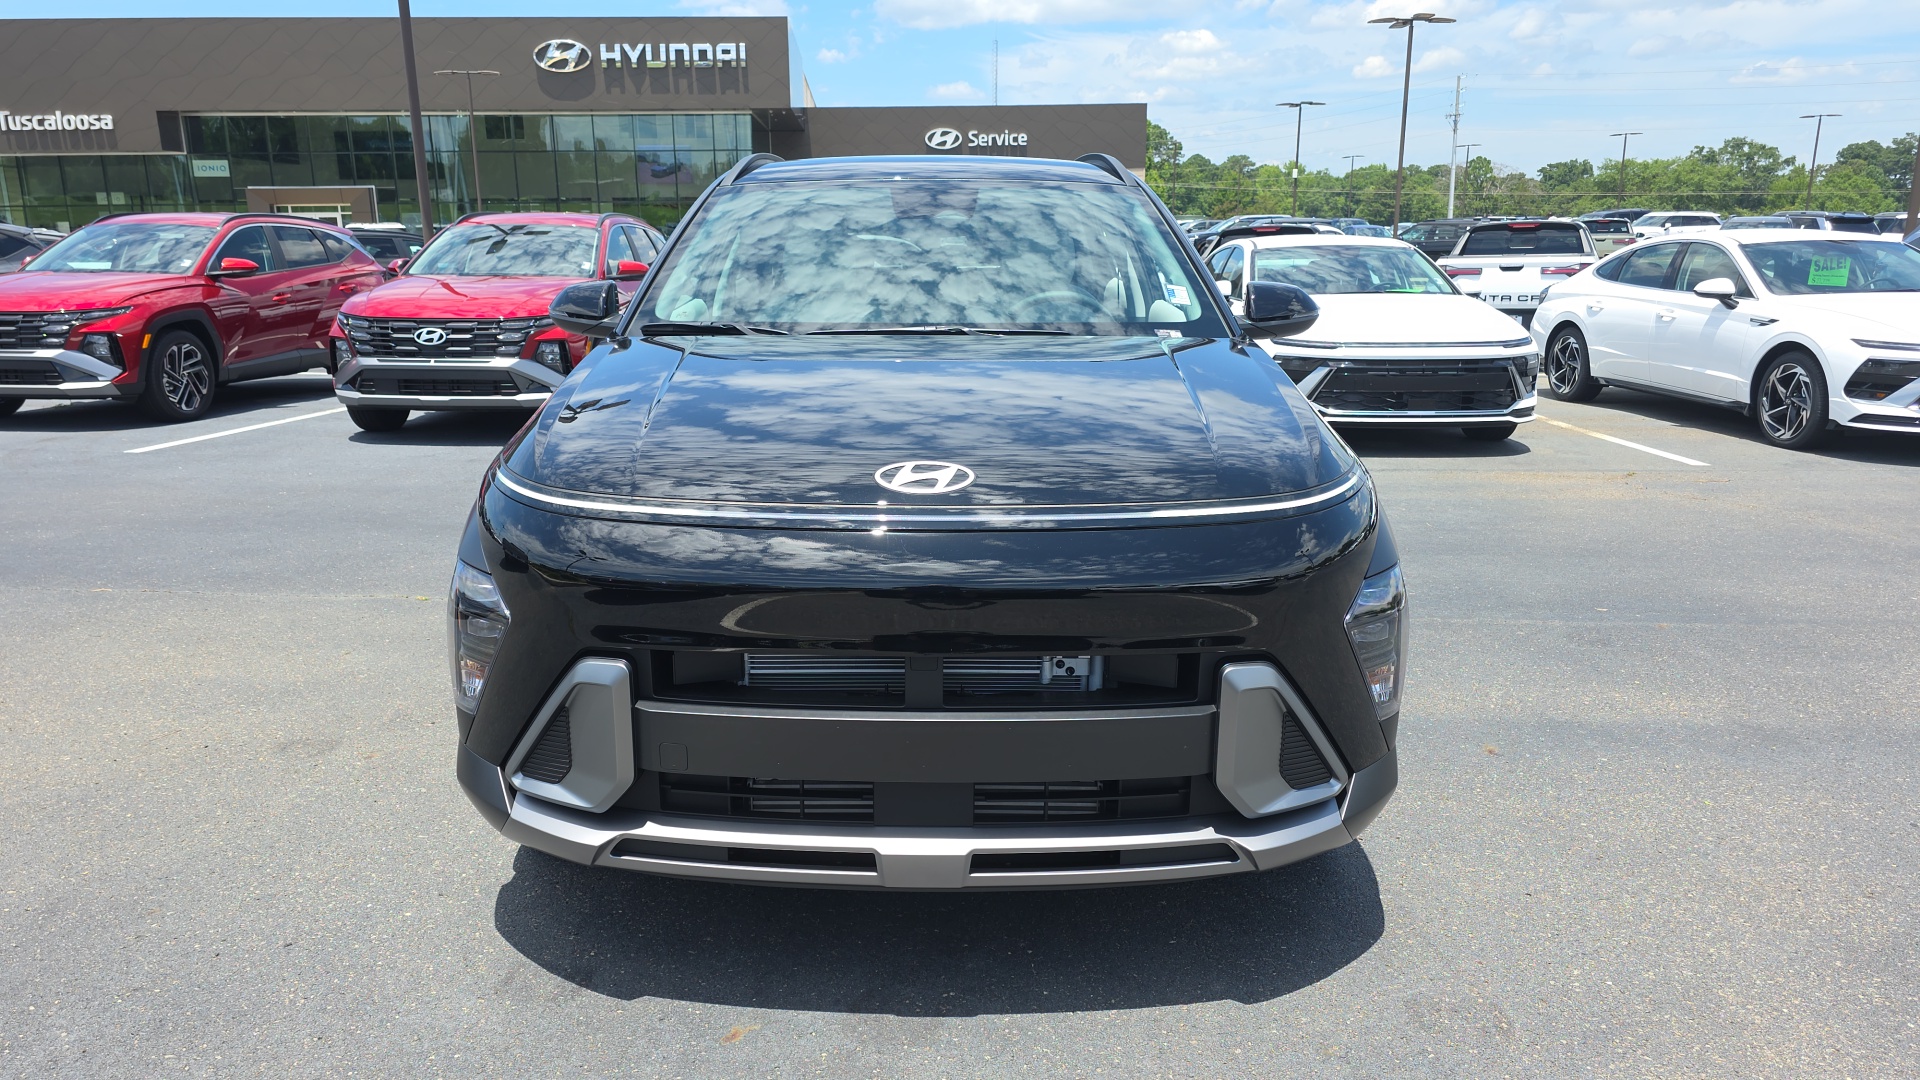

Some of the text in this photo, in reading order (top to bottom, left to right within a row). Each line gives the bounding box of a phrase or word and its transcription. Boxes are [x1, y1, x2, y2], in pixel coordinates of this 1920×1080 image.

[599, 42, 747, 69] HYUNDAI
[0, 110, 114, 131] Tuscaloosa
[967, 129, 1028, 147] Service
[1813, 256, 1848, 272] SALE!
[1475, 294, 1512, 302] NTA
